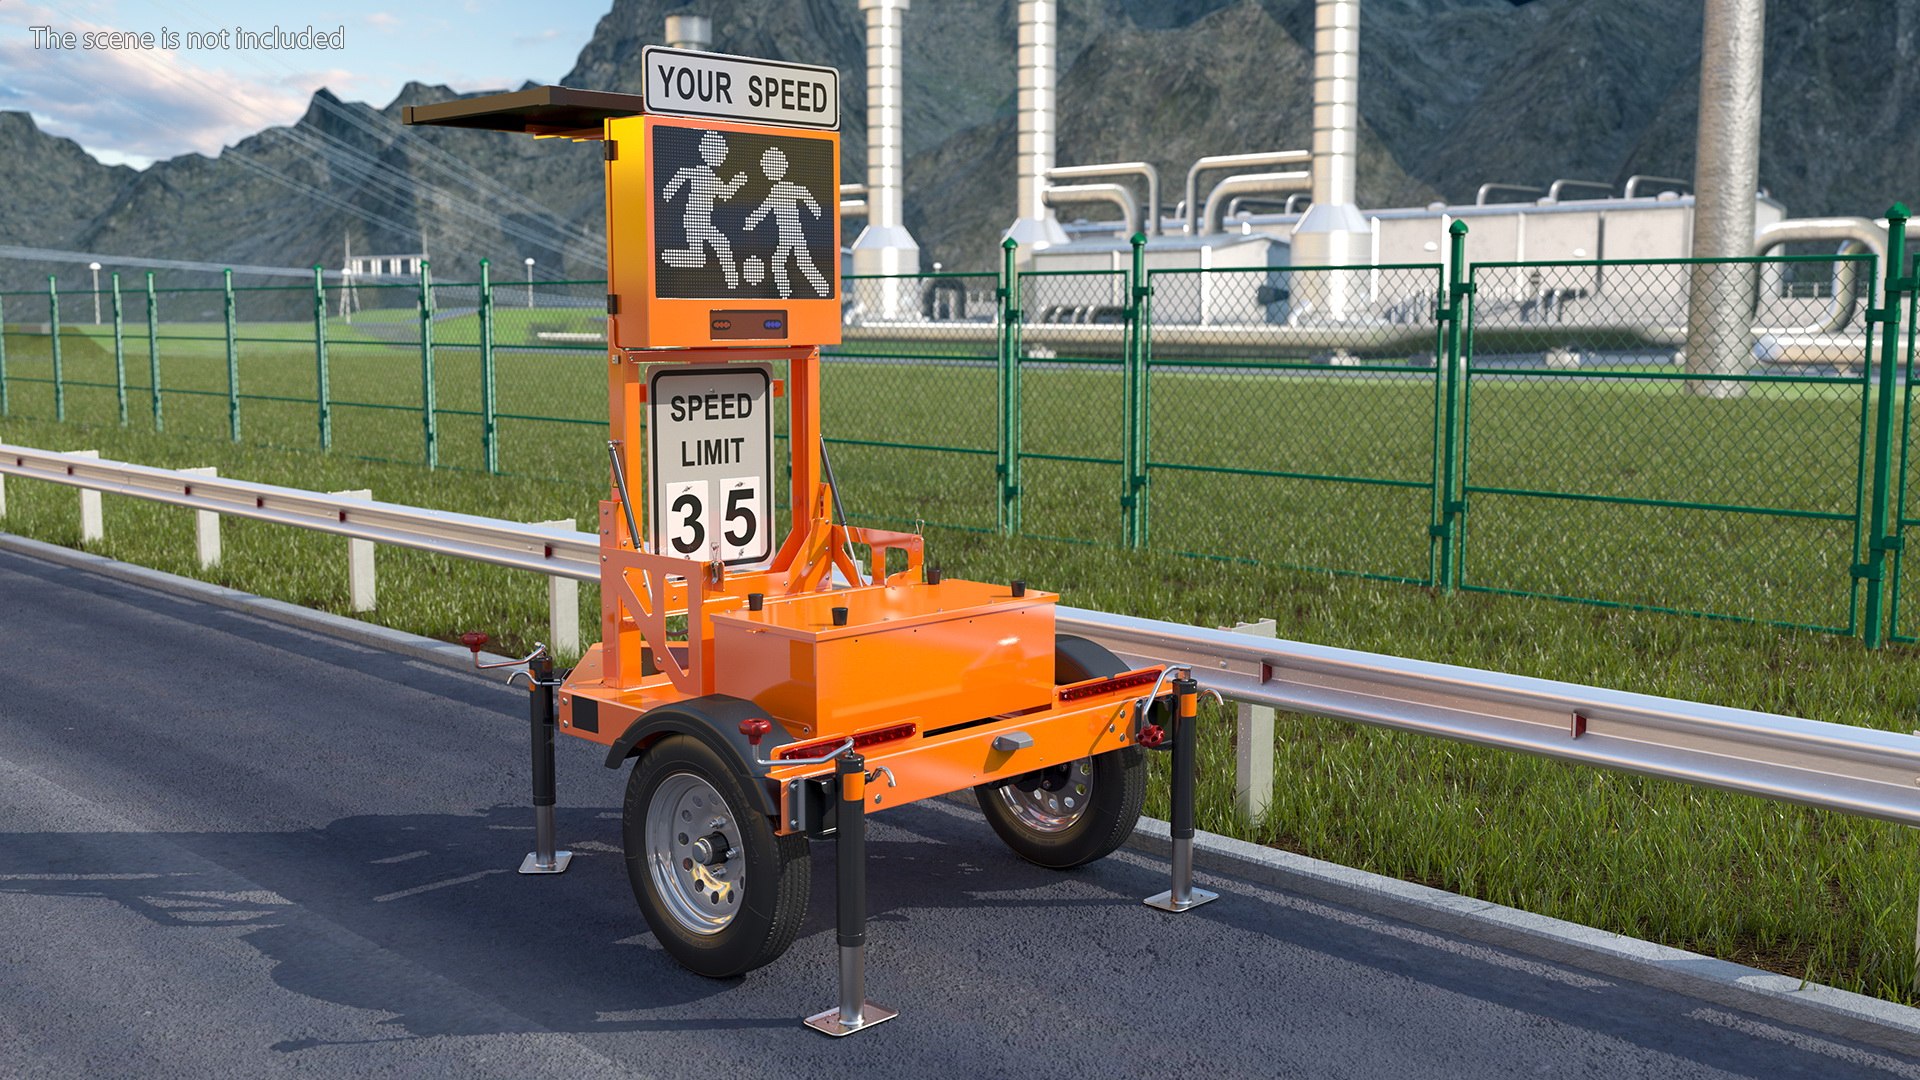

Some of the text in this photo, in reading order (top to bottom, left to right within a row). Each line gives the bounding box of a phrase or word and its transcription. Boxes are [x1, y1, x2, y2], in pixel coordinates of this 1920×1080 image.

[657, 64, 828, 113] YOUR SPEED
[670, 392, 753, 422] SPEED
[681, 437, 745, 467] LIMIT
[671, 488, 757, 554] 35
